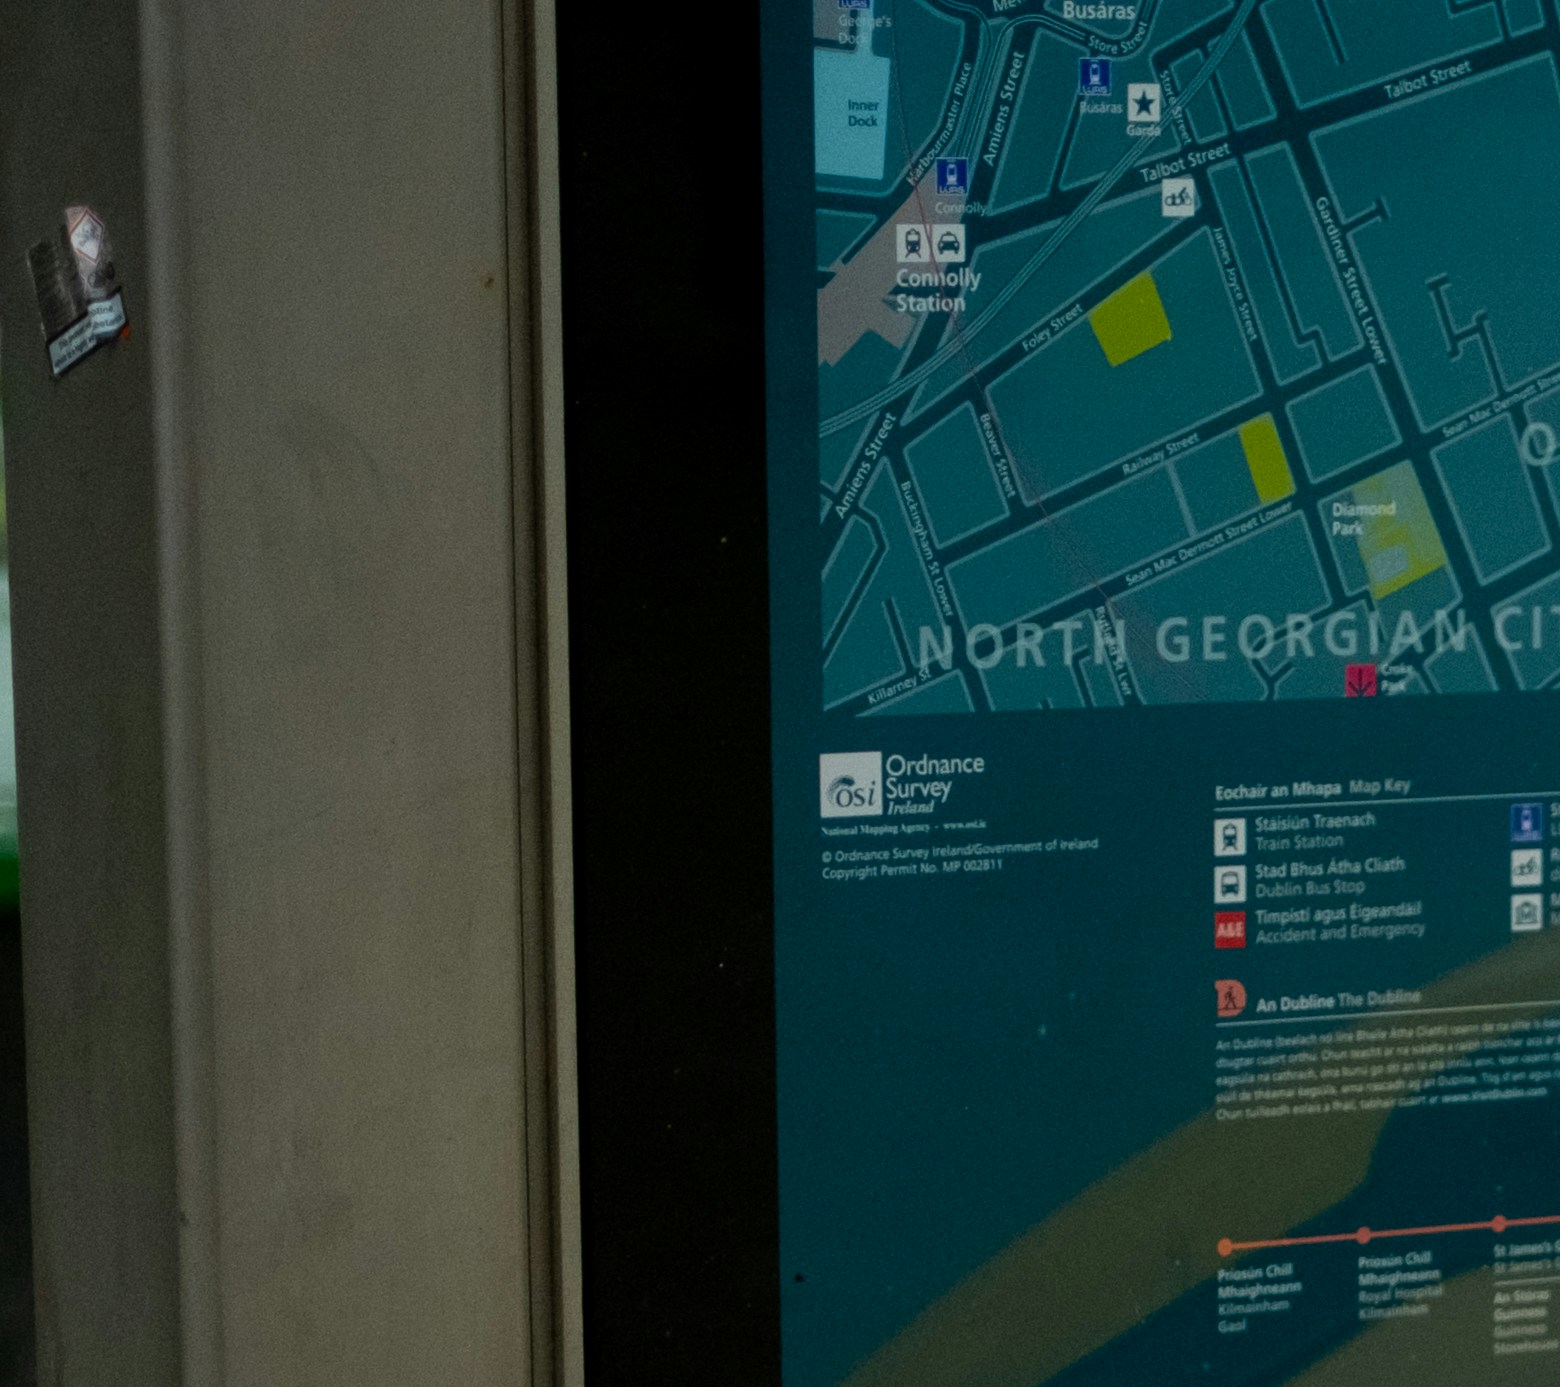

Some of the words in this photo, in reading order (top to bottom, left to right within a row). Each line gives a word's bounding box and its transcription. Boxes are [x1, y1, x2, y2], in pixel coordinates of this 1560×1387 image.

[1063, 0, 1137, 20] Busáras
[1088, 34, 1118, 55] Store
[1120, 21, 1148, 52] Street
[954, 61, 972, 104] Place
[1384, 75, 1428, 100] Talbot
[1429, 60, 1472, 87] Street
[848, 100, 879, 111] Inner
[983, 101, 1010, 166] Amiens
[1000, 50, 1025, 100] Street
[849, 115, 878, 127] Dock
[1139, 155, 1186, 183] Talbot
[1187, 143, 1231, 168] Street
[935, 202, 987, 216] Connolly
[896, 268, 982, 291] Connolly
[1213, 227, 1230, 263] James
[1238, 300, 1258, 342] Street
[1315, 196, 1349, 266] Gardiner
[1342, 265, 1369, 319] Street
[1362, 314, 1387, 366] Lower
[896, 293, 966, 313] Station
[1022, 323, 1053, 352] Foley
[1050, 303, 1084, 335] Street
[979, 412, 1003, 459] Beaver
[995, 455, 1017, 499] Street
[1121, 448, 1164, 476] Railway
[1164, 431, 1200, 458] Street
[835, 457, 873, 520] Amiens
[863, 411, 897, 463] Street
[1332, 501, 1396, 518] Diamond
[900, 480, 934, 563] Buckingham
[1332, 520, 1364, 536] Park
[1125, 564, 1154, 587] Sean
[1154, 554, 1177, 576] Mac
[1225, 516, 1259, 542] Street
[1258, 501, 1293, 528] Lower
[928, 561, 941, 583] St
[933, 577, 954, 618] Lower
[918, 615, 1126, 671] NORTH
[1156, 606, 1466, 664] GEORGIAN
[867, 672, 920, 706] Killarney
[918, 667, 932, 683] St
[885, 753, 985, 777] Ordnance
[836, 780, 876, 808] osi
[885, 777, 952, 803] Survey
[1215, 785, 1268, 801] Eochair
[1270, 785, 1289, 798] an
[1292, 781, 1343, 799] Mhapa
[1349, 779, 1382, 796] Map
[1384, 778, 1412, 795] Key
[887, 801, 935, 816] Ireland
[1312, 812, 1377, 829] Traenach
[835, 850, 890, 863] Ordnance
[892, 847, 929, 861] Survey
[1045, 839, 1057, 851] of
[1255, 836, 1291, 851] Train
[1294, 833, 1345, 849] Station
[822, 866, 878, 881] Copyright
[881, 863, 917, 877] Permit
[920, 862, 939, 874] No.
[943, 861, 960, 873] MP
[1255, 863, 1287, 880] Stad
[1290, 861, 1324, 878] Bhus
[1364, 856, 1407, 874] Cliath
[1255, 882, 1303, 899] Dublin
[1305, 880, 1332, 895] Bus
[1333, 879, 1367, 896] Stop
[1313, 906, 1347, 925] agus
[1255, 927, 1317, 944] Accident
[1320, 925, 1347, 940] and
[1349, 922, 1426, 941] Emergency
[1256, 998, 1278, 1013] An
[1280, 993, 1336, 1012] Dubline
[1338, 991, 1364, 1008] The
[1266, 1262, 1294, 1279] Chill
[1217, 1299, 1290, 1316] Kilmainham
[1218, 1318, 1246, 1333] Gaol
